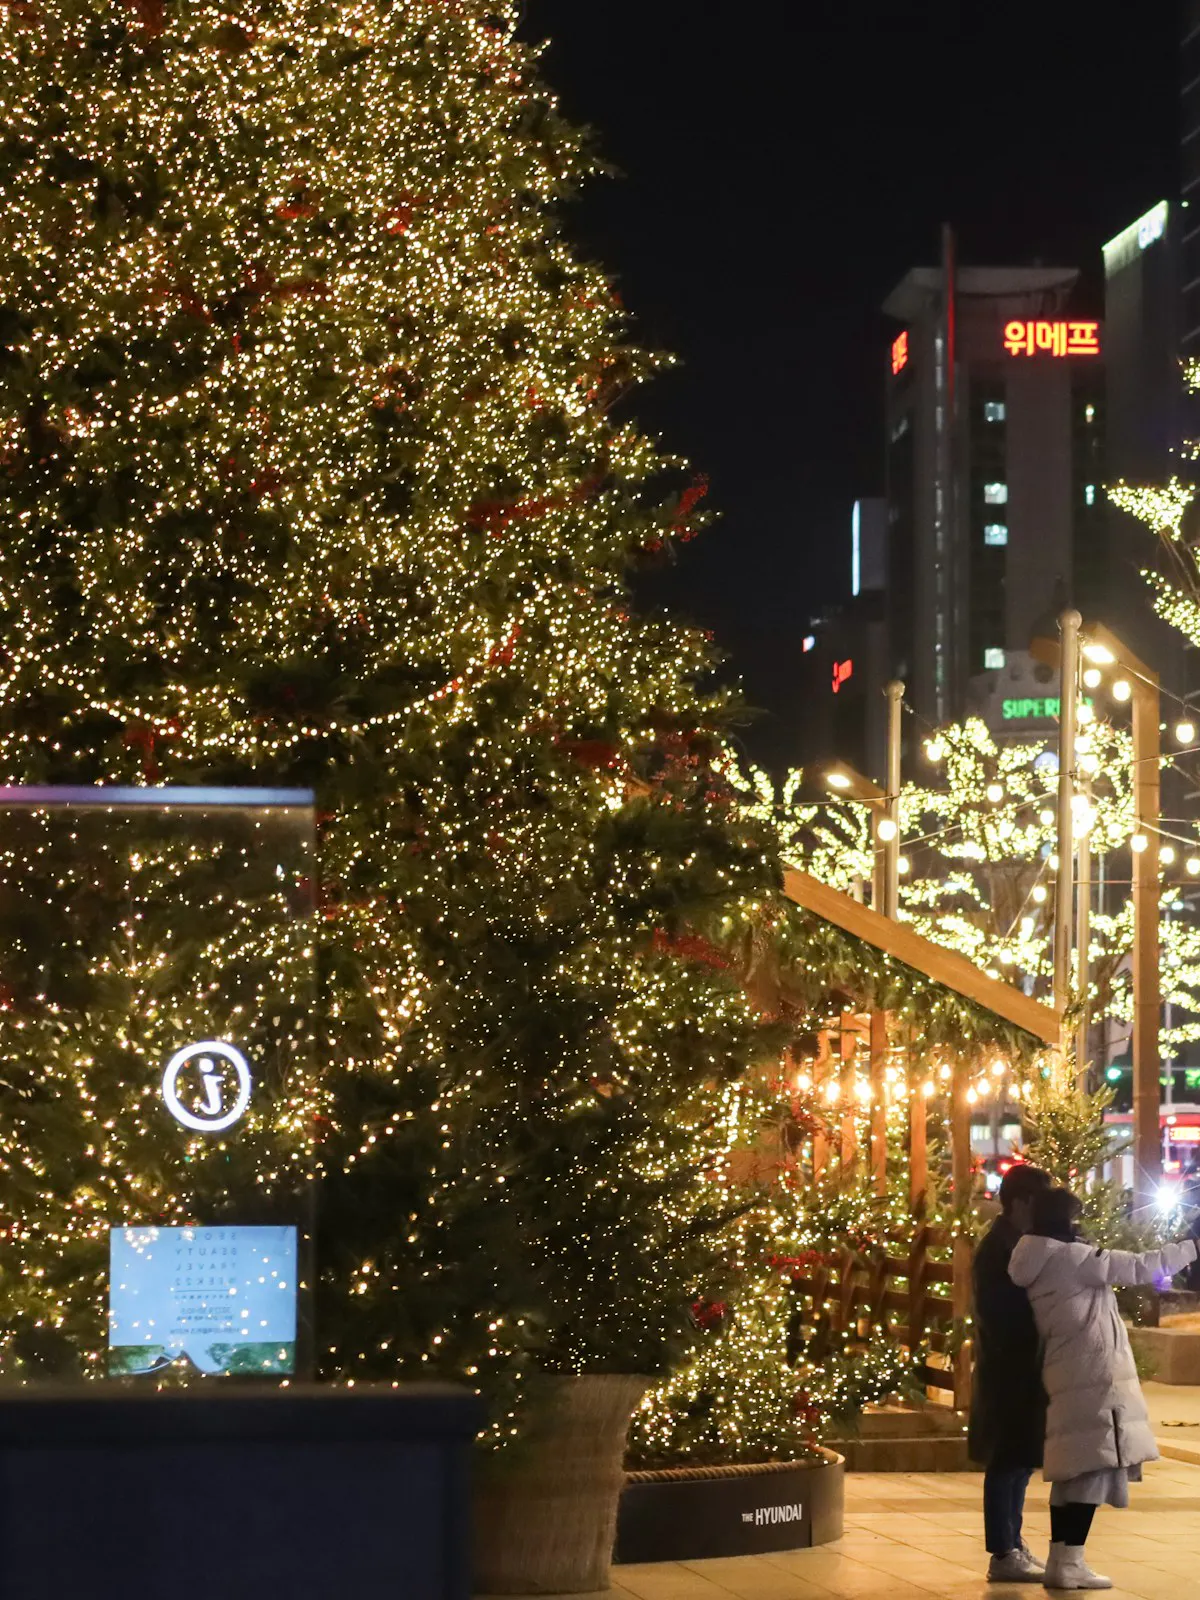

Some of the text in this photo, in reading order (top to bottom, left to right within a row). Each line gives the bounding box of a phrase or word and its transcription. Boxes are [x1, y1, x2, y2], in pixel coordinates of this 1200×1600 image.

[1003, 321, 1099, 356] 위메프
[741, 1503, 802, 1525] THE HYUNDAI
